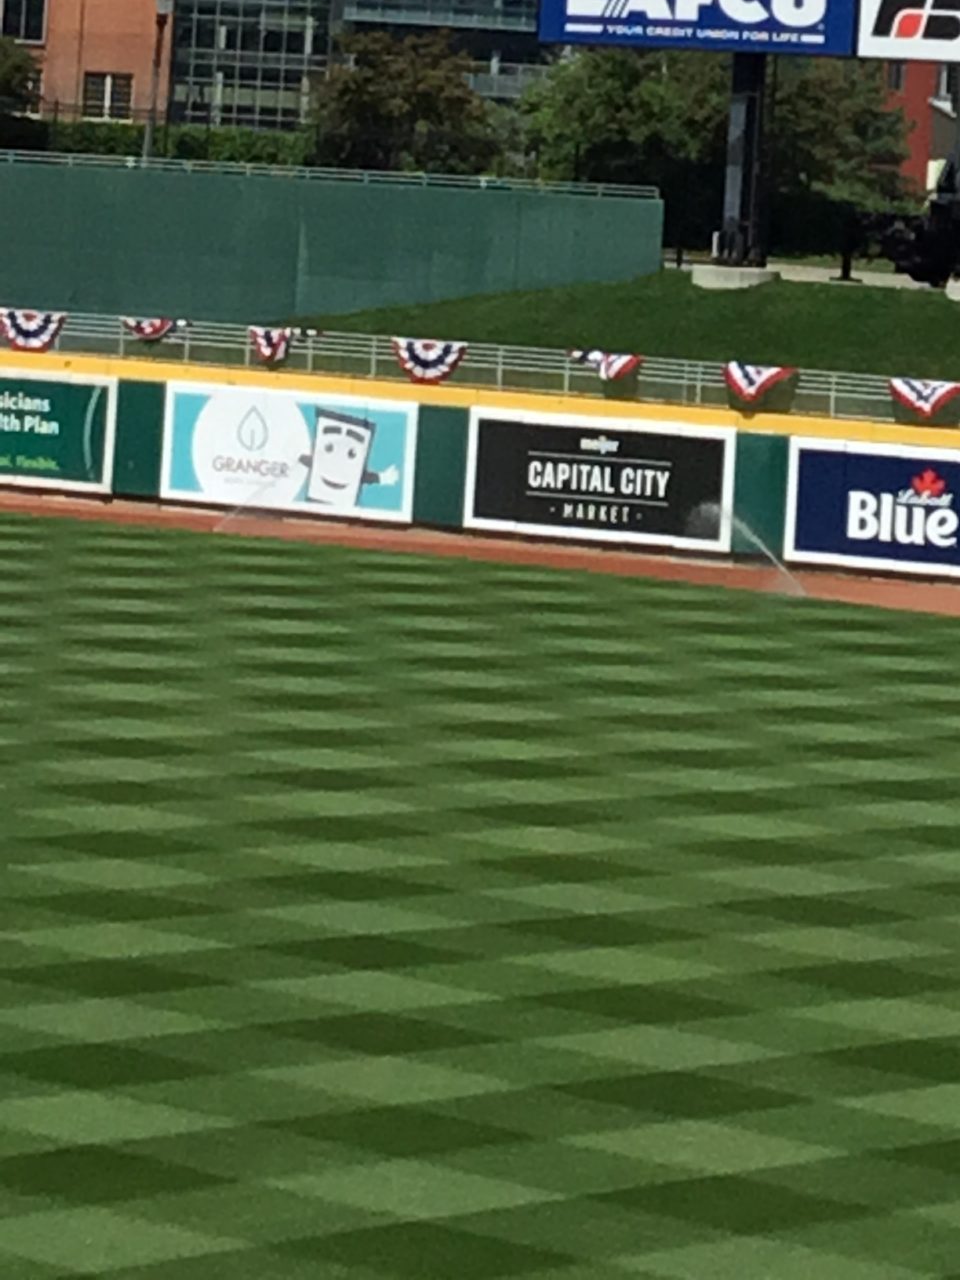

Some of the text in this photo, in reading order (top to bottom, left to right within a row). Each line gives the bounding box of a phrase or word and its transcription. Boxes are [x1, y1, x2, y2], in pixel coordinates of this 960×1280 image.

[606, 24, 800, 43] YOUR CREDIT UNION FOR LIFE
[23, 414, 60, 436] Plan
[211, 454, 290, 479] GRANGER
[527, 460, 671, 499] CAPITAL CITY
[562, 502, 631, 524] MARKET
[846, 490, 960, 549] Blue
